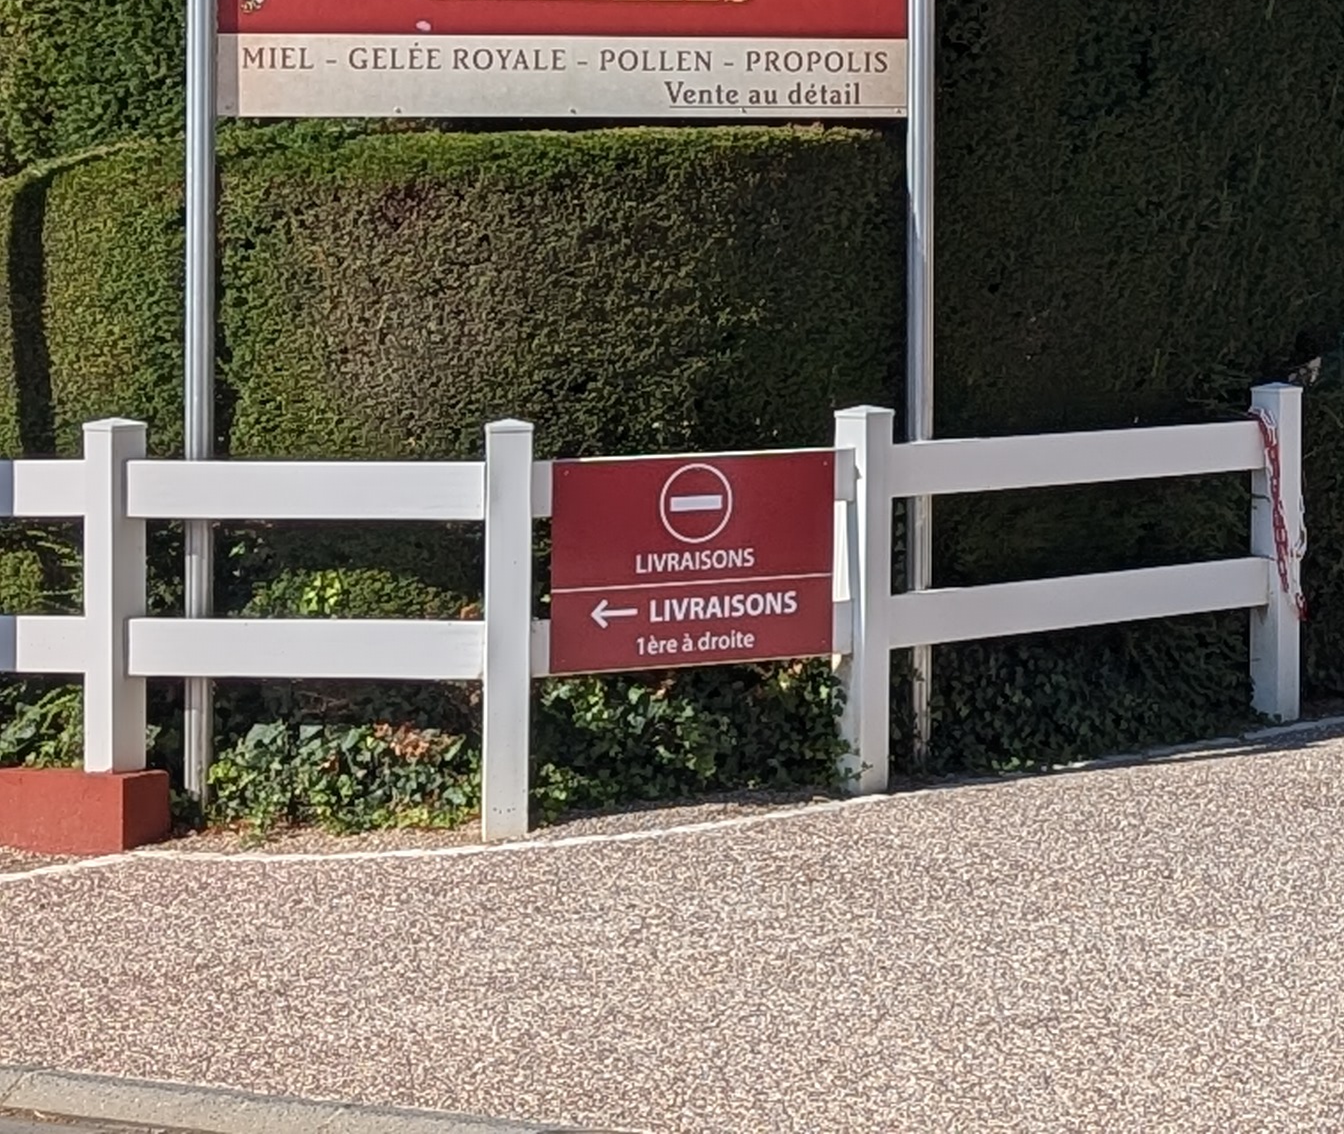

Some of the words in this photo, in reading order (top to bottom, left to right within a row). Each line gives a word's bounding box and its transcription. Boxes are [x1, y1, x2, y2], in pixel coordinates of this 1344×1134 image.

[242, 47, 314, 70] MIEL
[348, 42, 442, 70] GELÉE
[452, 48, 566, 71] ROYALE
[600, 49, 712, 72] POLLEN
[745, 50, 889, 73] PROPOLIS
[664, 81, 739, 105] Vente
[748, 88, 778, 105] au
[787, 82, 862, 105] détail
[635, 548, 755, 574] LIVRAISONS
[650, 591, 797, 623] LIVRAISONS
[637, 634, 678, 655] 1ère
[682, 633, 694, 653] à
[697, 630, 755, 652] droite
